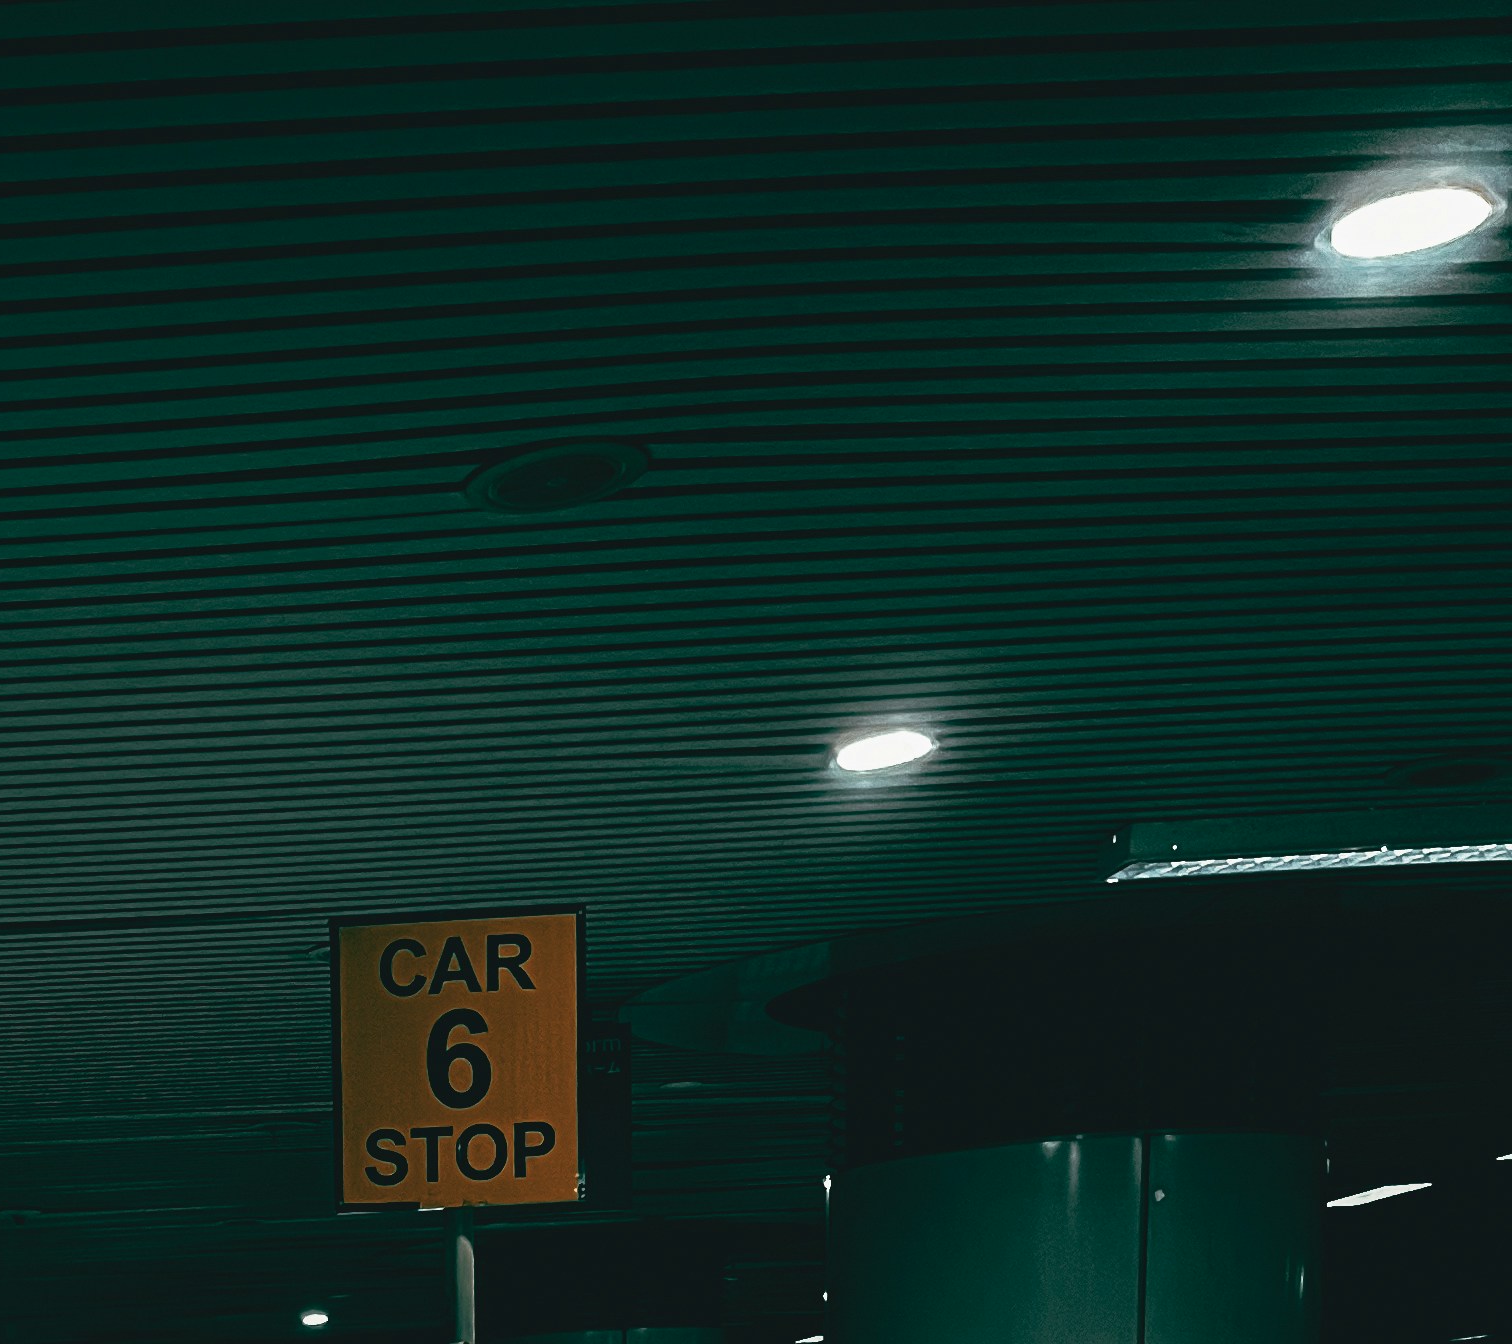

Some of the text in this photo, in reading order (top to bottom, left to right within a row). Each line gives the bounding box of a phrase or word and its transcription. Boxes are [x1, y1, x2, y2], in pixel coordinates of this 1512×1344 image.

[379, 933, 537, 998] CAR
[426, 1007, 493, 1111] 6
[364, 1120, 557, 1187] STOP
